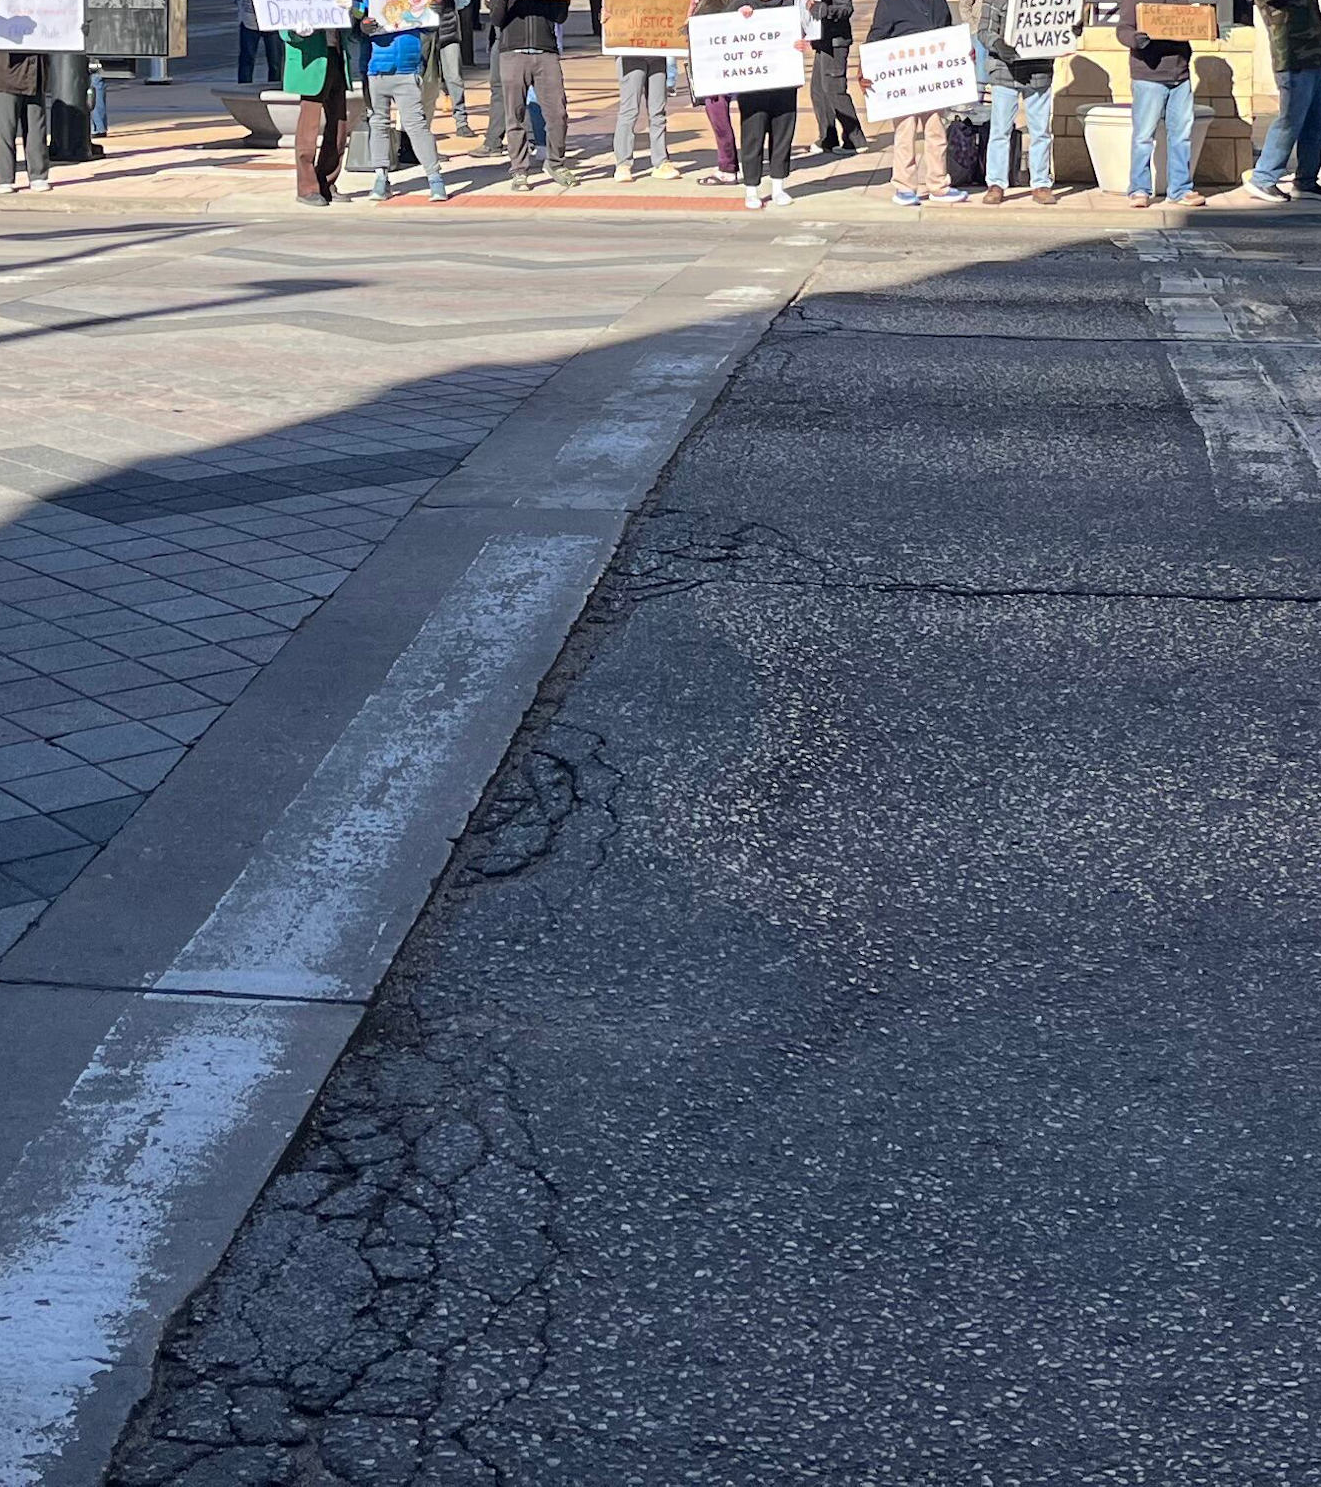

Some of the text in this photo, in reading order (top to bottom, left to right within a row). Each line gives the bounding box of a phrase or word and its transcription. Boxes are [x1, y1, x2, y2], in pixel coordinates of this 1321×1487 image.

[629, 16, 674, 29] JUSTICE
[1016, 9, 1076, 30] FASCISM
[709, 31, 781, 45] ICE AND CBP
[1015, 29, 1070, 48] ALWAYS
[723, 50, 764, 61] OUT OF
[937, 56, 967, 69] ROSS
[722, 66, 769, 78] KANSAS
[886, 77, 964, 99] FOR MURDER
